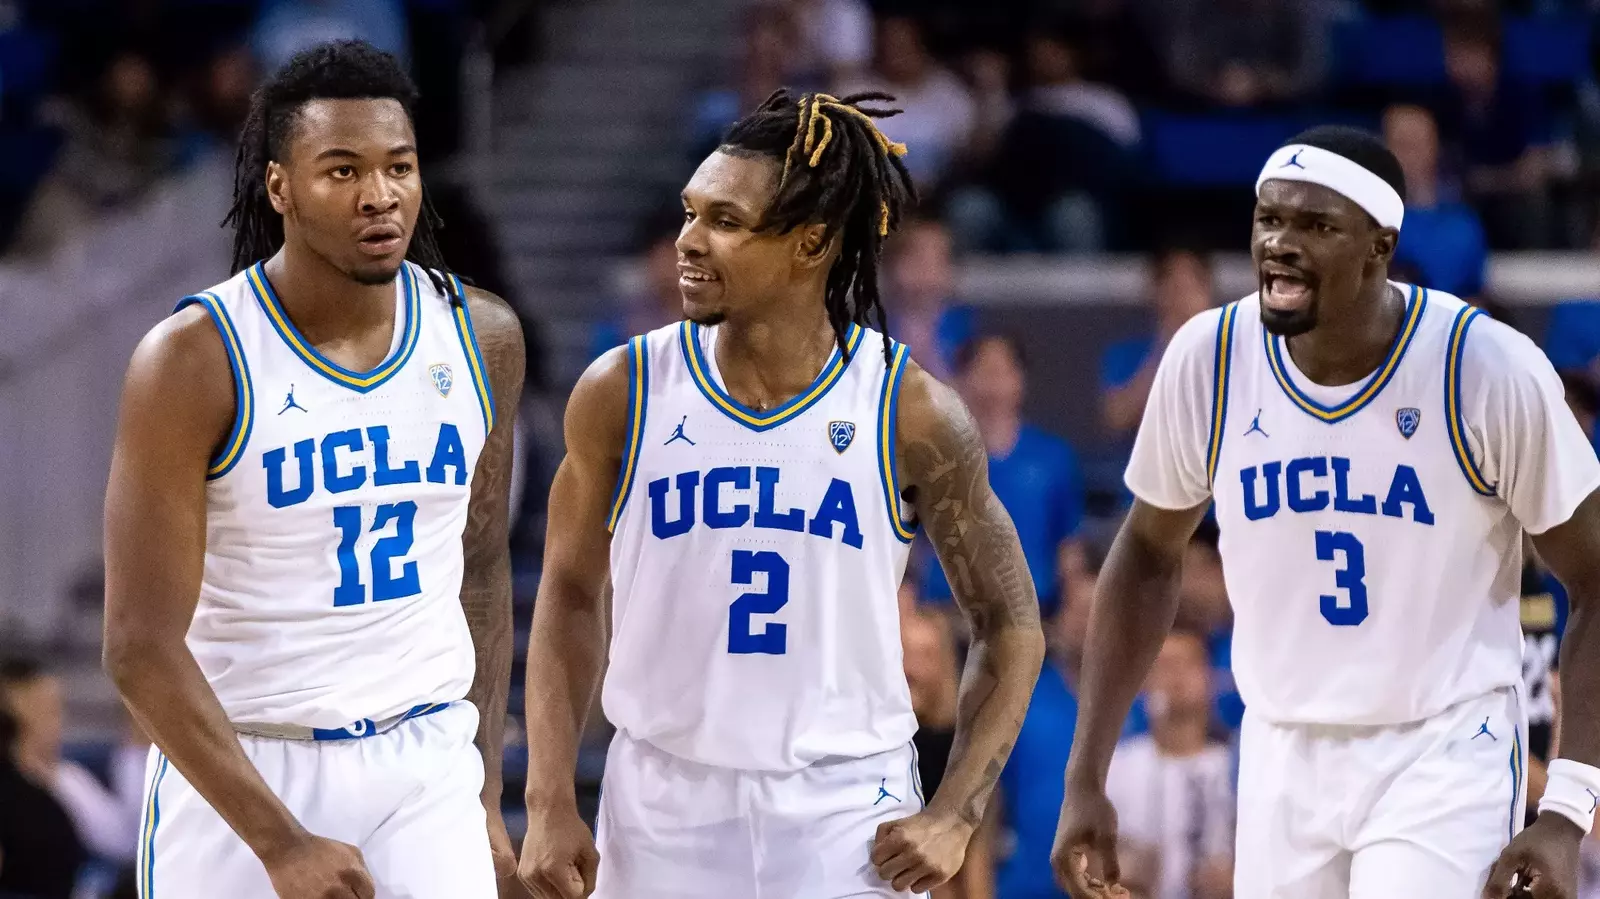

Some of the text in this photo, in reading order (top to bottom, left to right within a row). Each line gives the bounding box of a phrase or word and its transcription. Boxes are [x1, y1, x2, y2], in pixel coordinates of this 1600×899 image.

[262, 422, 468, 508] UCLA
[830, 422, 855, 441] PAC
[834, 434, 848, 446] 12
[649, 465, 864, 550] UCLA
[1239, 456, 1435, 525] UCLA
[333, 500, 422, 608] 12
[1315, 530, 1369, 626] 3
[728, 549, 790, 655] 2
